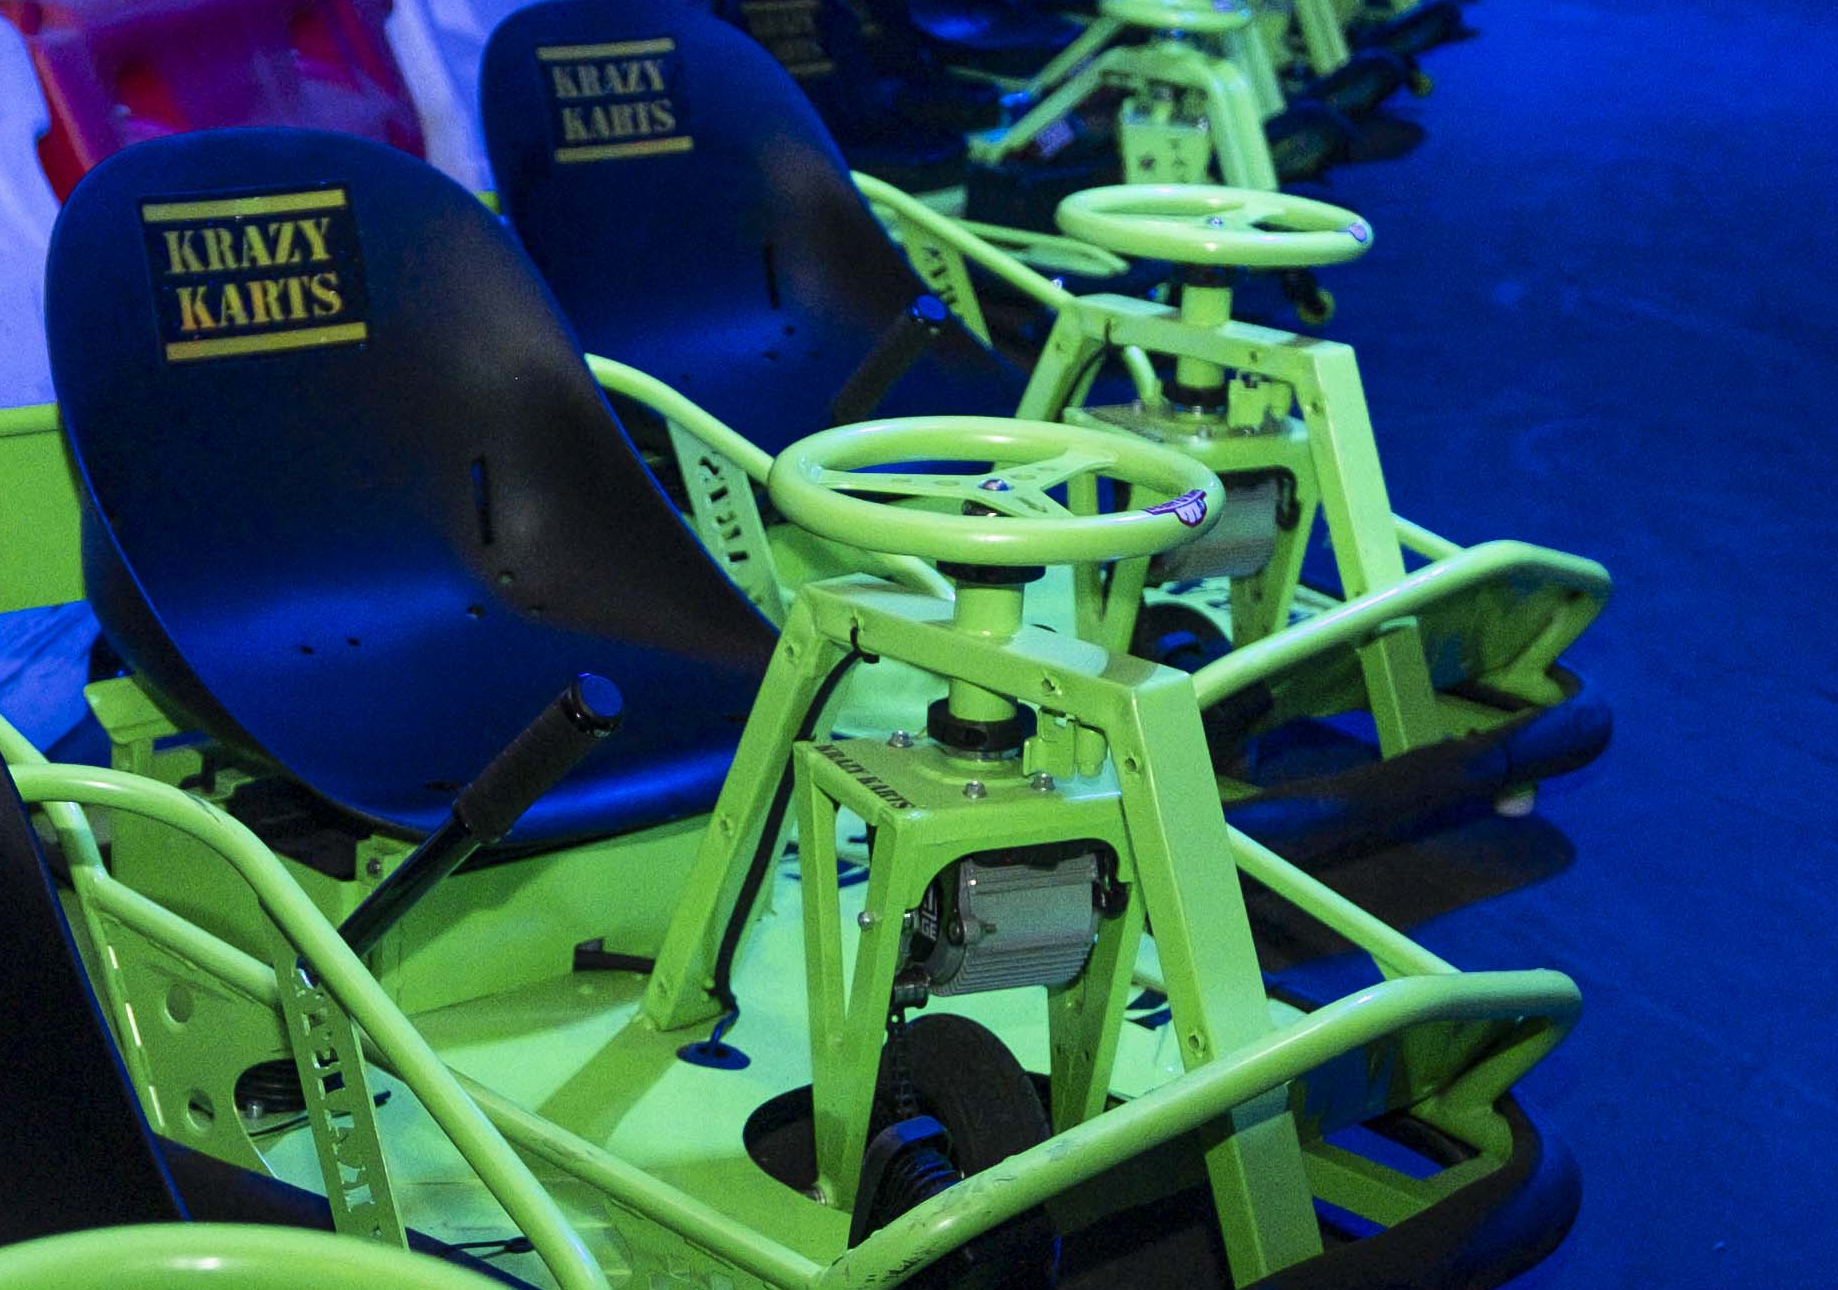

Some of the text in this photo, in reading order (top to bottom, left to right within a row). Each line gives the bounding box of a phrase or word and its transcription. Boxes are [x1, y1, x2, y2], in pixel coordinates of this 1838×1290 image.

[553, 59, 665, 98] KRAZY
[562, 99, 676, 140] KARTS
[164, 217, 331, 275] KRAZY
[176, 271, 343, 331] KARTS
